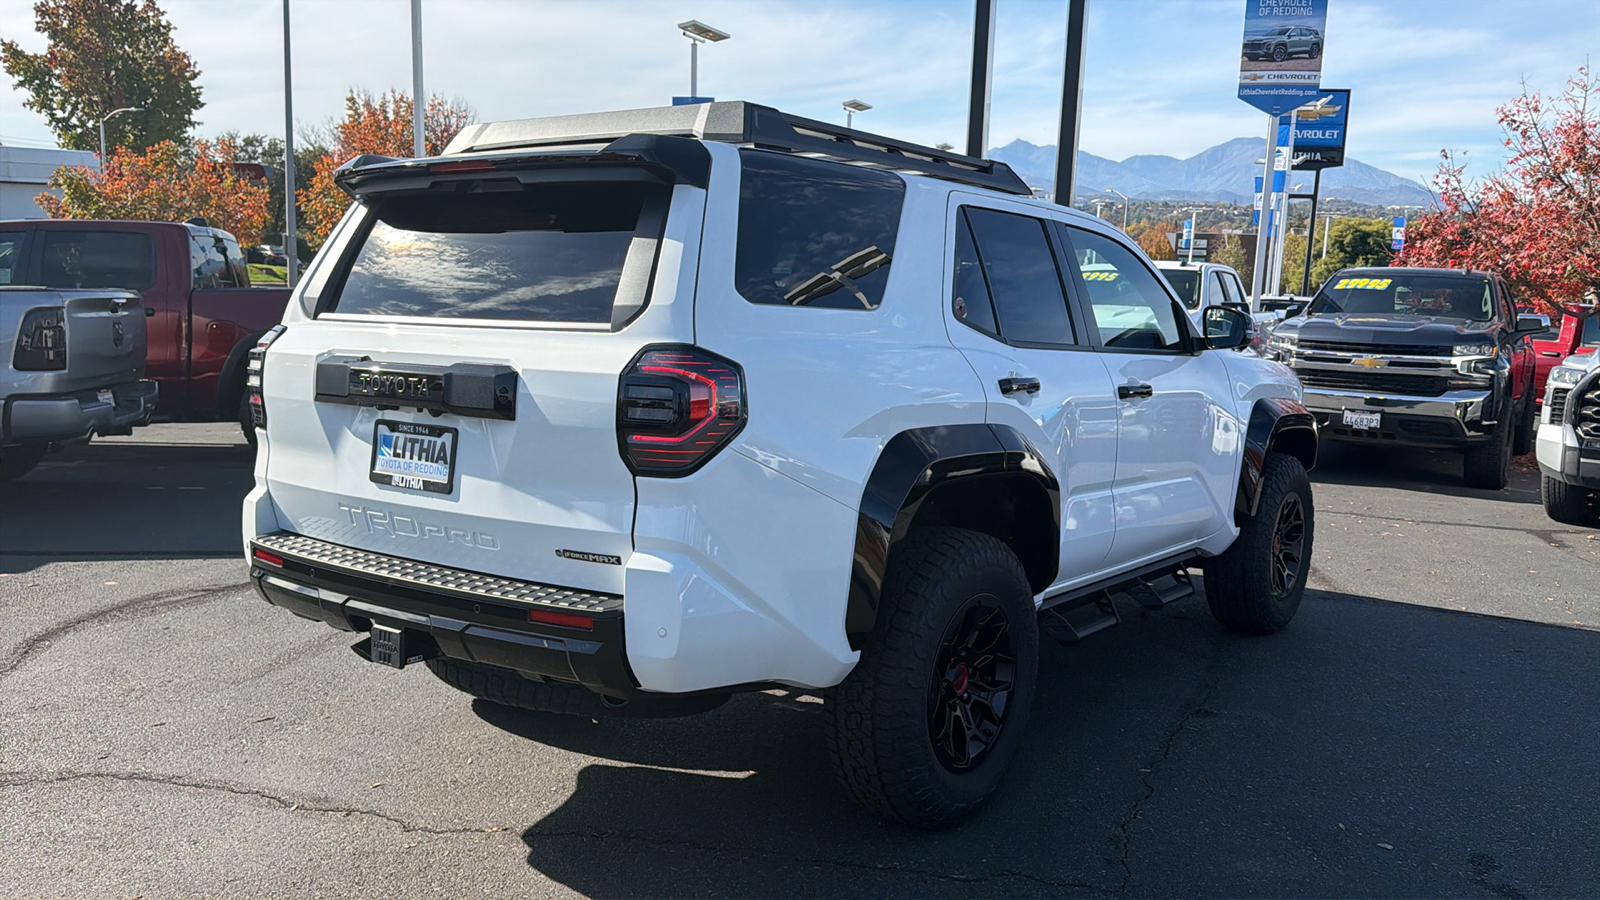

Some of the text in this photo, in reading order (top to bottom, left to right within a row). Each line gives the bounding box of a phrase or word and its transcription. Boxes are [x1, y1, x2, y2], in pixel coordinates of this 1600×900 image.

[1258, 7, 1313, 16] OF REDDING
[1240, 88, 1317, 96] LithiaChevroletRedding.com
[1294, 152, 1322, 161] ITHIA
[1333, 278, 1393, 290] 29995
[359, 373, 432, 397] TOYOTA
[398, 424, 414, 433] SINCE
[392, 435, 449, 465] LITHIA
[378, 457, 448, 477] TOYOTA OF REDDING
[338, 502, 500, 551] TRD PRO
[372, 640, 399, 655] TOYOTA
